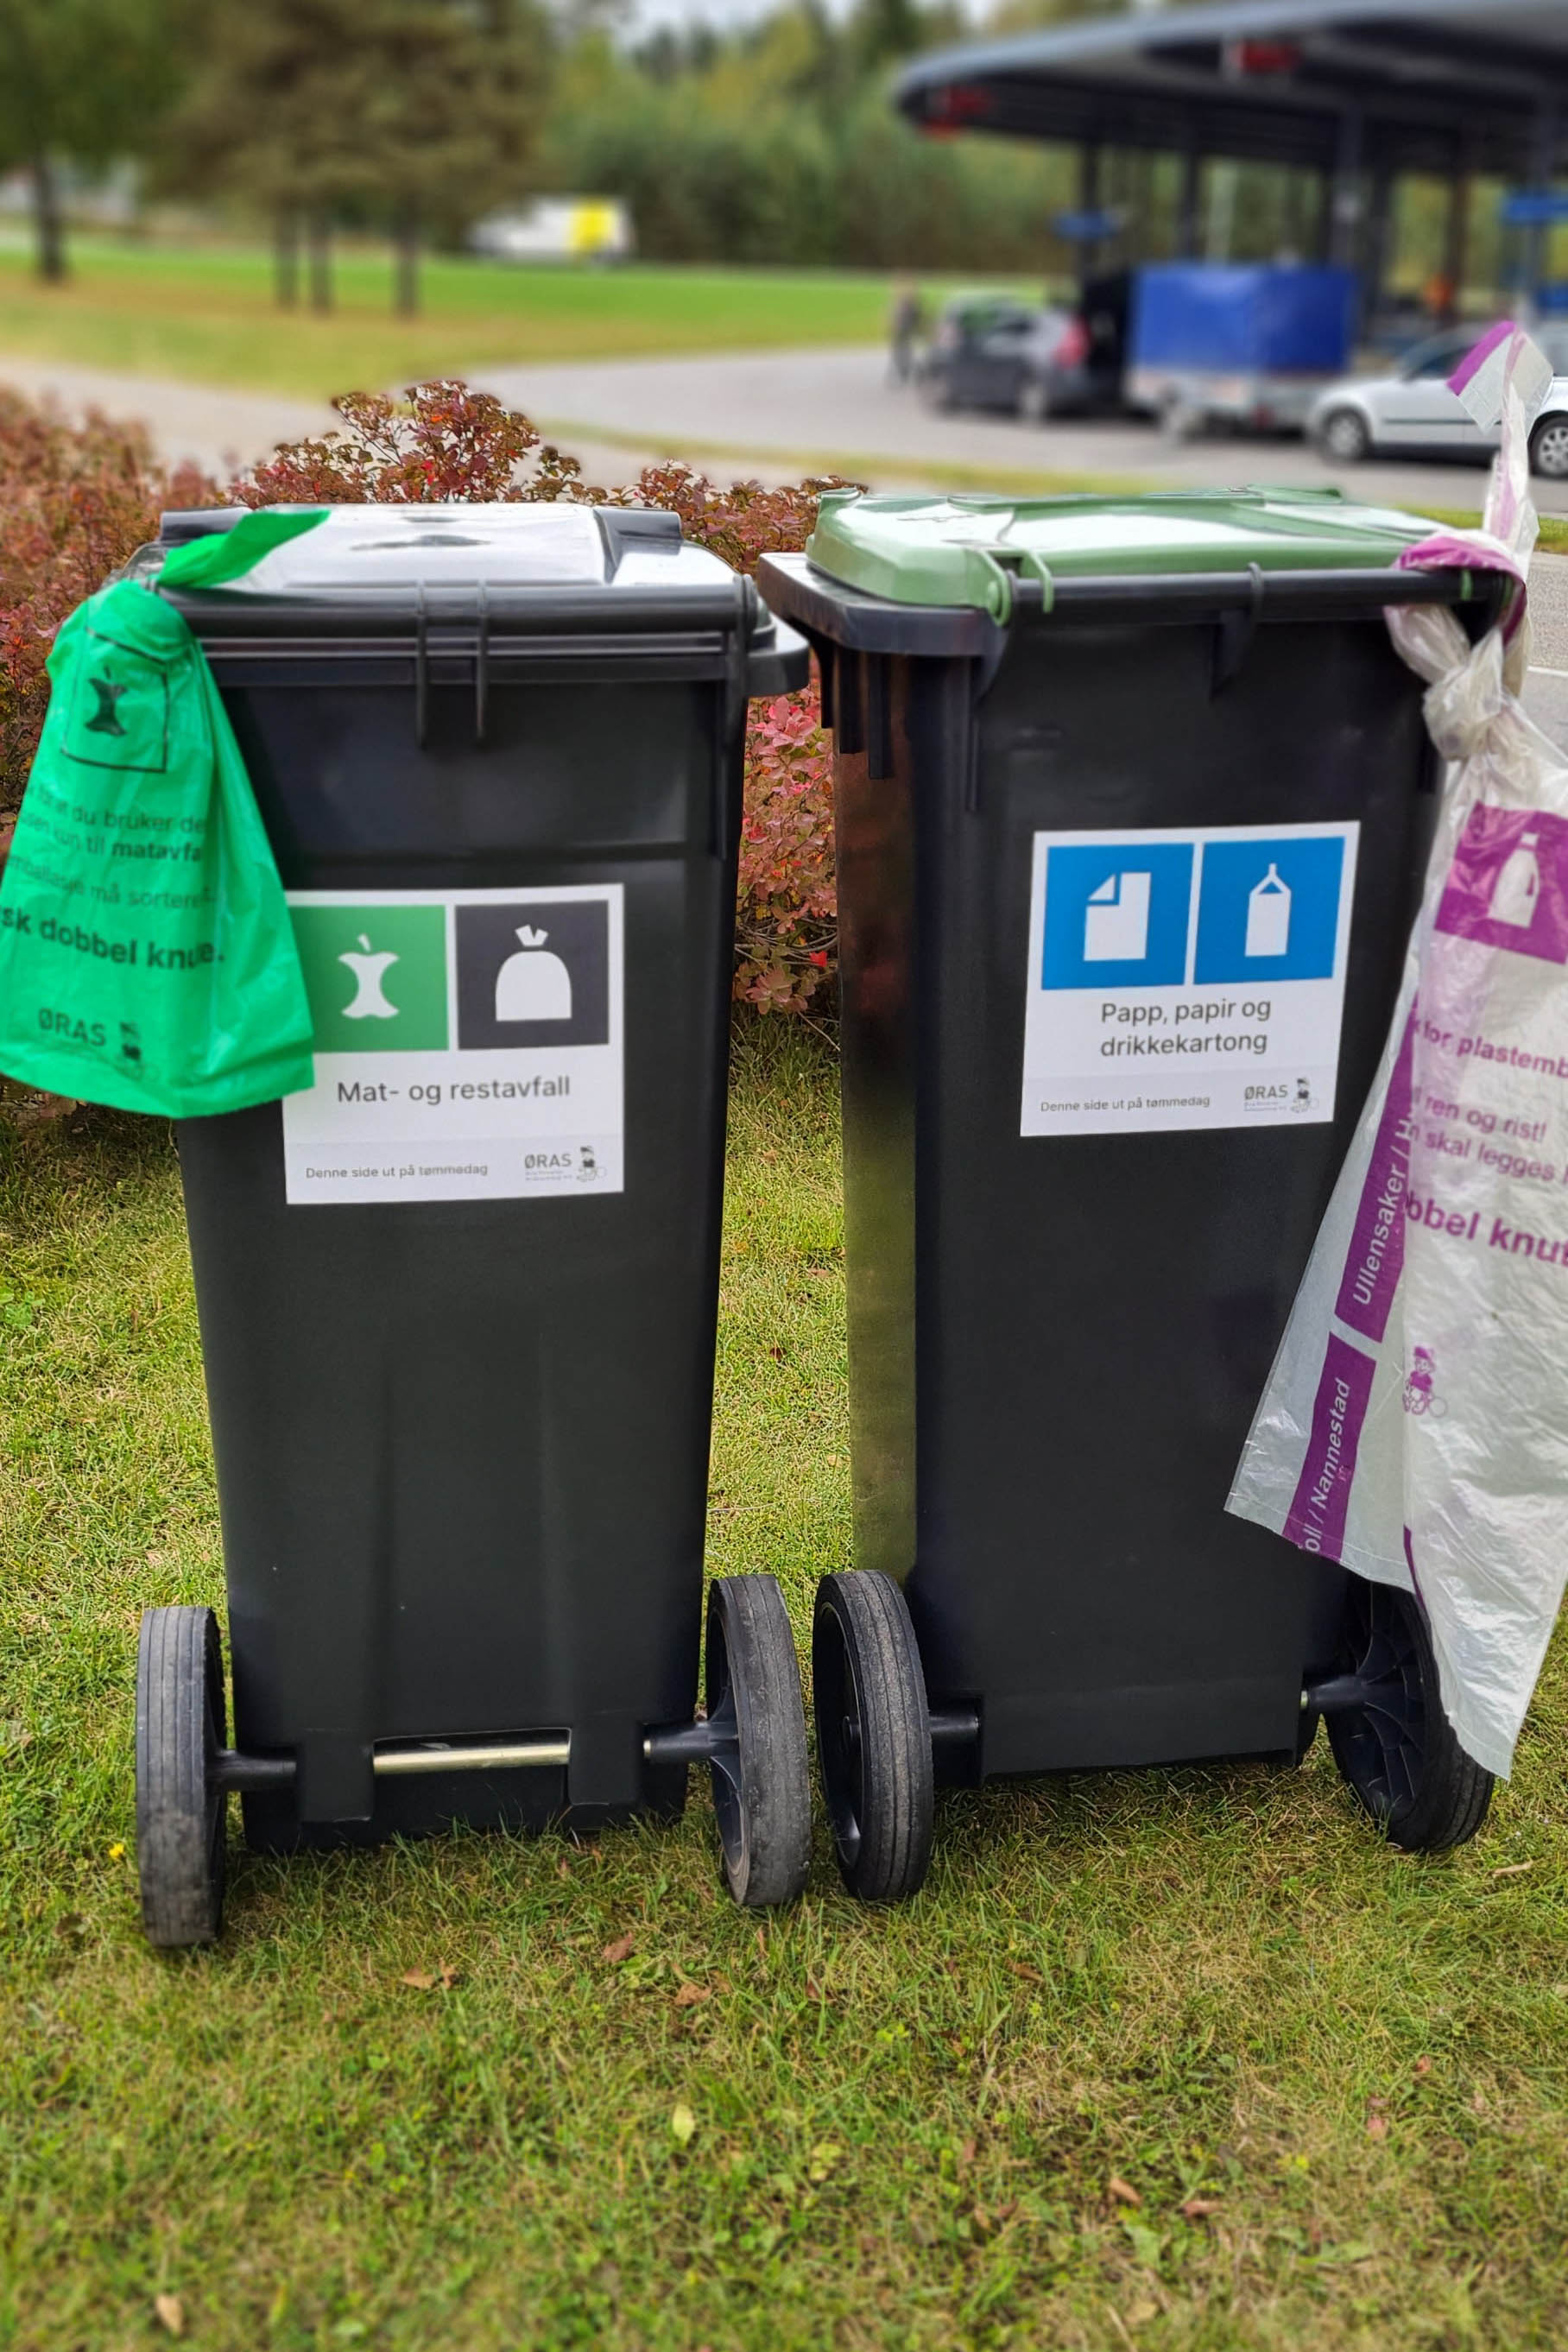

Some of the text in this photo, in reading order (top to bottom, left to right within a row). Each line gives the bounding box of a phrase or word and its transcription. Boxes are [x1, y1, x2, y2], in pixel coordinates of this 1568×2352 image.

[103, 809, 173, 833] bruker
[87, 832, 105, 856] til
[90, 882, 121, 904] må
[39, 918, 137, 964] dobbel
[1101, 998, 1272, 1027] Papp, papir og
[39, 1008, 106, 1046] ØRAS
[1101, 1033, 1268, 1057] drikkekartong
[338, 1076, 571, 1106] Mat- og restavfall
[1040, 1095, 1211, 1112] Denne side ut på tømmedag
[1244, 1085, 1288, 1100] ØRAS
[1426, 1096, 1460, 1121] ren
[1467, 1109, 1498, 1135] og
[524, 1154, 572, 1168] ØRAS
[1426, 1131, 1472, 1159] skal
[1477, 1141, 1555, 1182] legges
[306, 1163, 488, 1180] Denne side ut på tømmedag
[1352, 1162, 1407, 1306] Ullensaker
[1310, 1376, 1350, 1511] Nannestad
